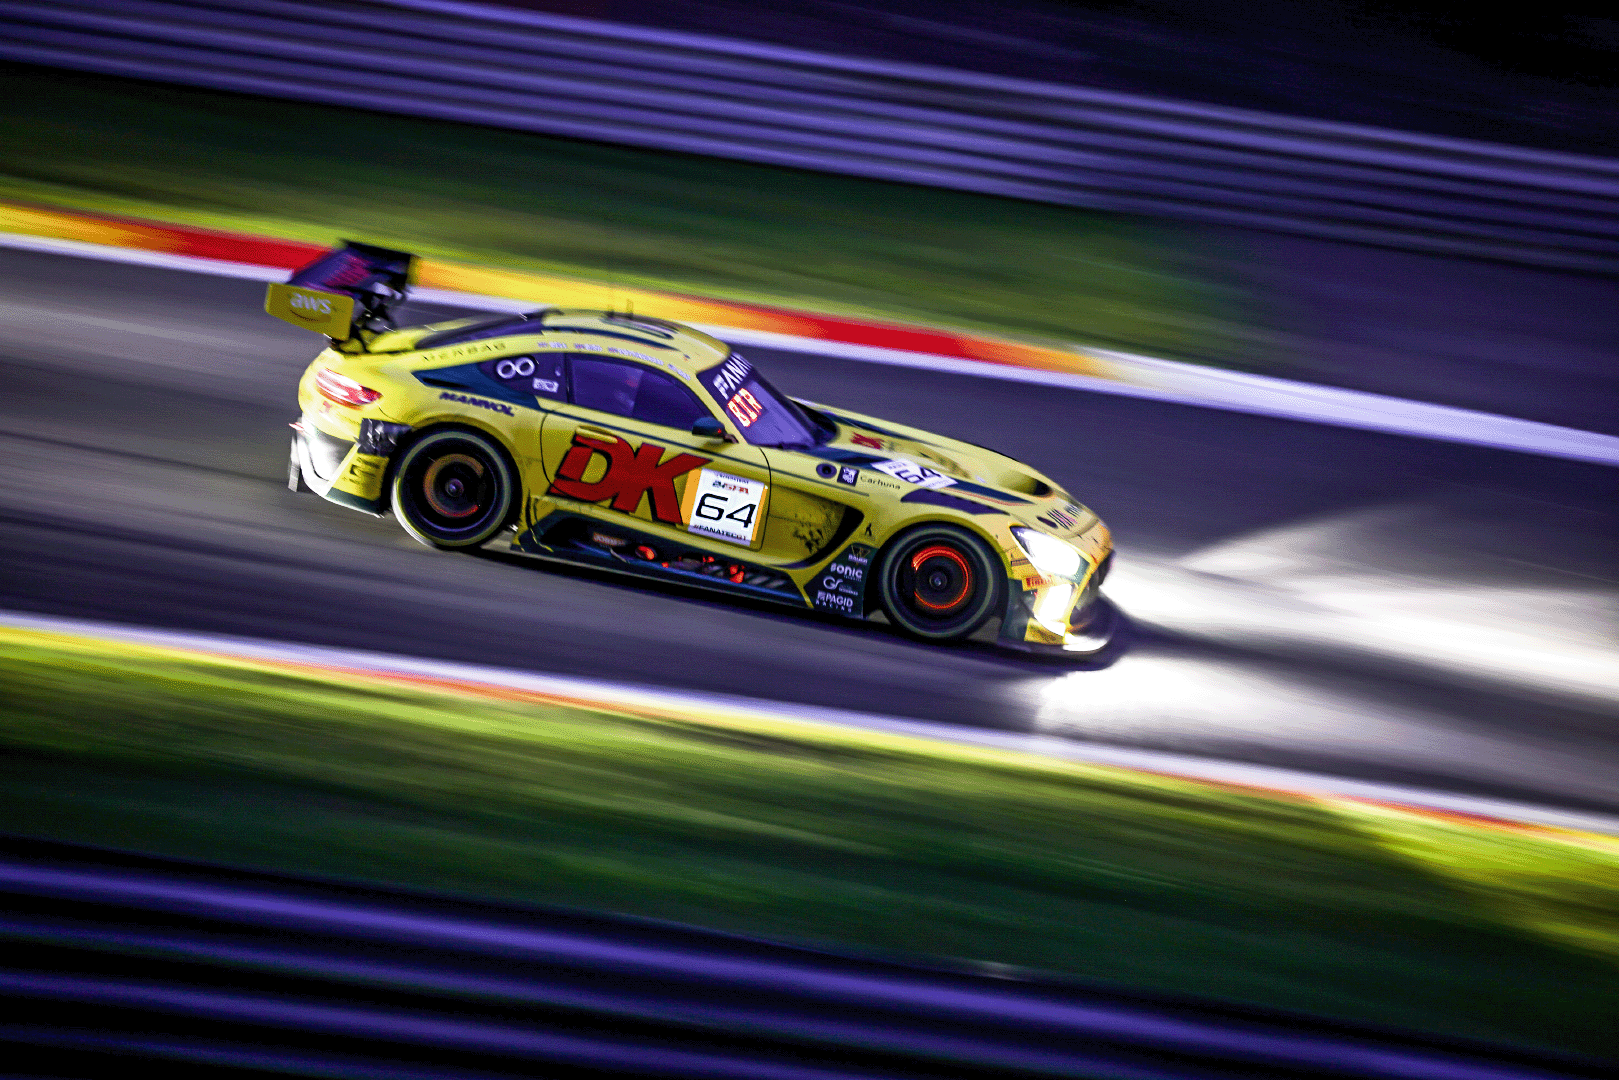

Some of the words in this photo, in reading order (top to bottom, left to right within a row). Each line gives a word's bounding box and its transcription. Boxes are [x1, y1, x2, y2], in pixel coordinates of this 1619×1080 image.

[439, 392, 515, 417] MANNOL
[548, 433, 714, 526] DK
[894, 467, 942, 484] 64
[695, 492, 757, 529] 64
[825, 592, 853, 607] PAGID
